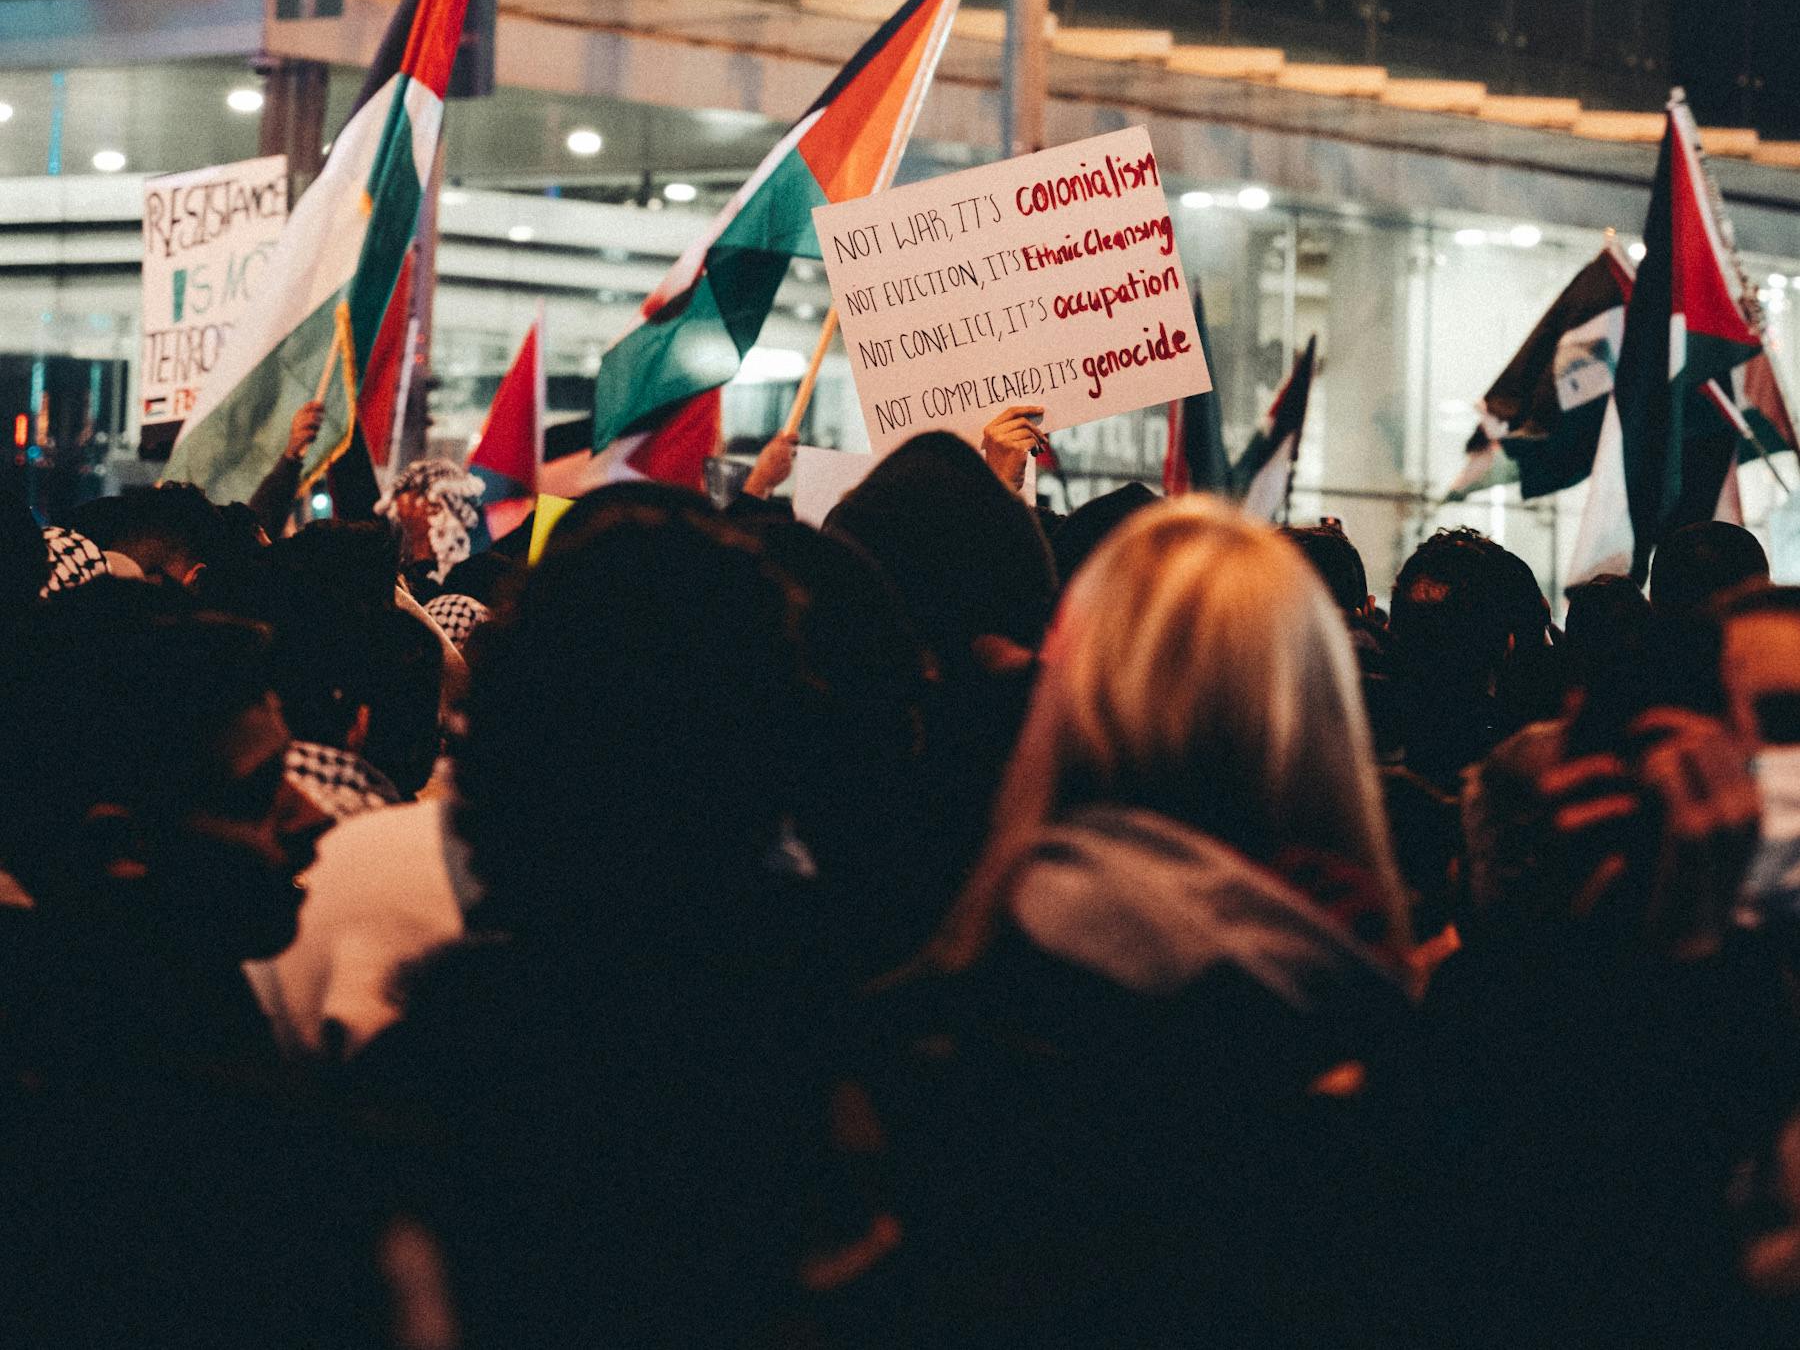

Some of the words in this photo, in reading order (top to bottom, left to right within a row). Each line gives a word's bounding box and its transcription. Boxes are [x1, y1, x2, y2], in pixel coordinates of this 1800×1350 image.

[833, 224, 882, 264] NOT
[891, 209, 953, 250] WAR,
[951, 193, 1001, 233] IT'S
[845, 285, 878, 317] NOT
[883, 260, 985, 307] EVICTION,
[982, 249, 1021, 283] IT'S
[1020, 233, 1083, 272] Ethnic
[1083, 215, 1174, 257] Cleansing
[172, 265, 213, 323] IS
[858, 338, 895, 370] NOT
[899, 311, 1003, 361] CONFLICT,
[1002, 296, 1048, 335] IT'S
[1053, 266, 1180, 320] occupation
[147, 322, 235, 384] TERRO
[874, 395, 912, 435] NOT
[921, 367, 1045, 420] COMPLICATED,
[1044, 358, 1078, 390] IT'S
[1082, 322, 1192, 400] genocide
